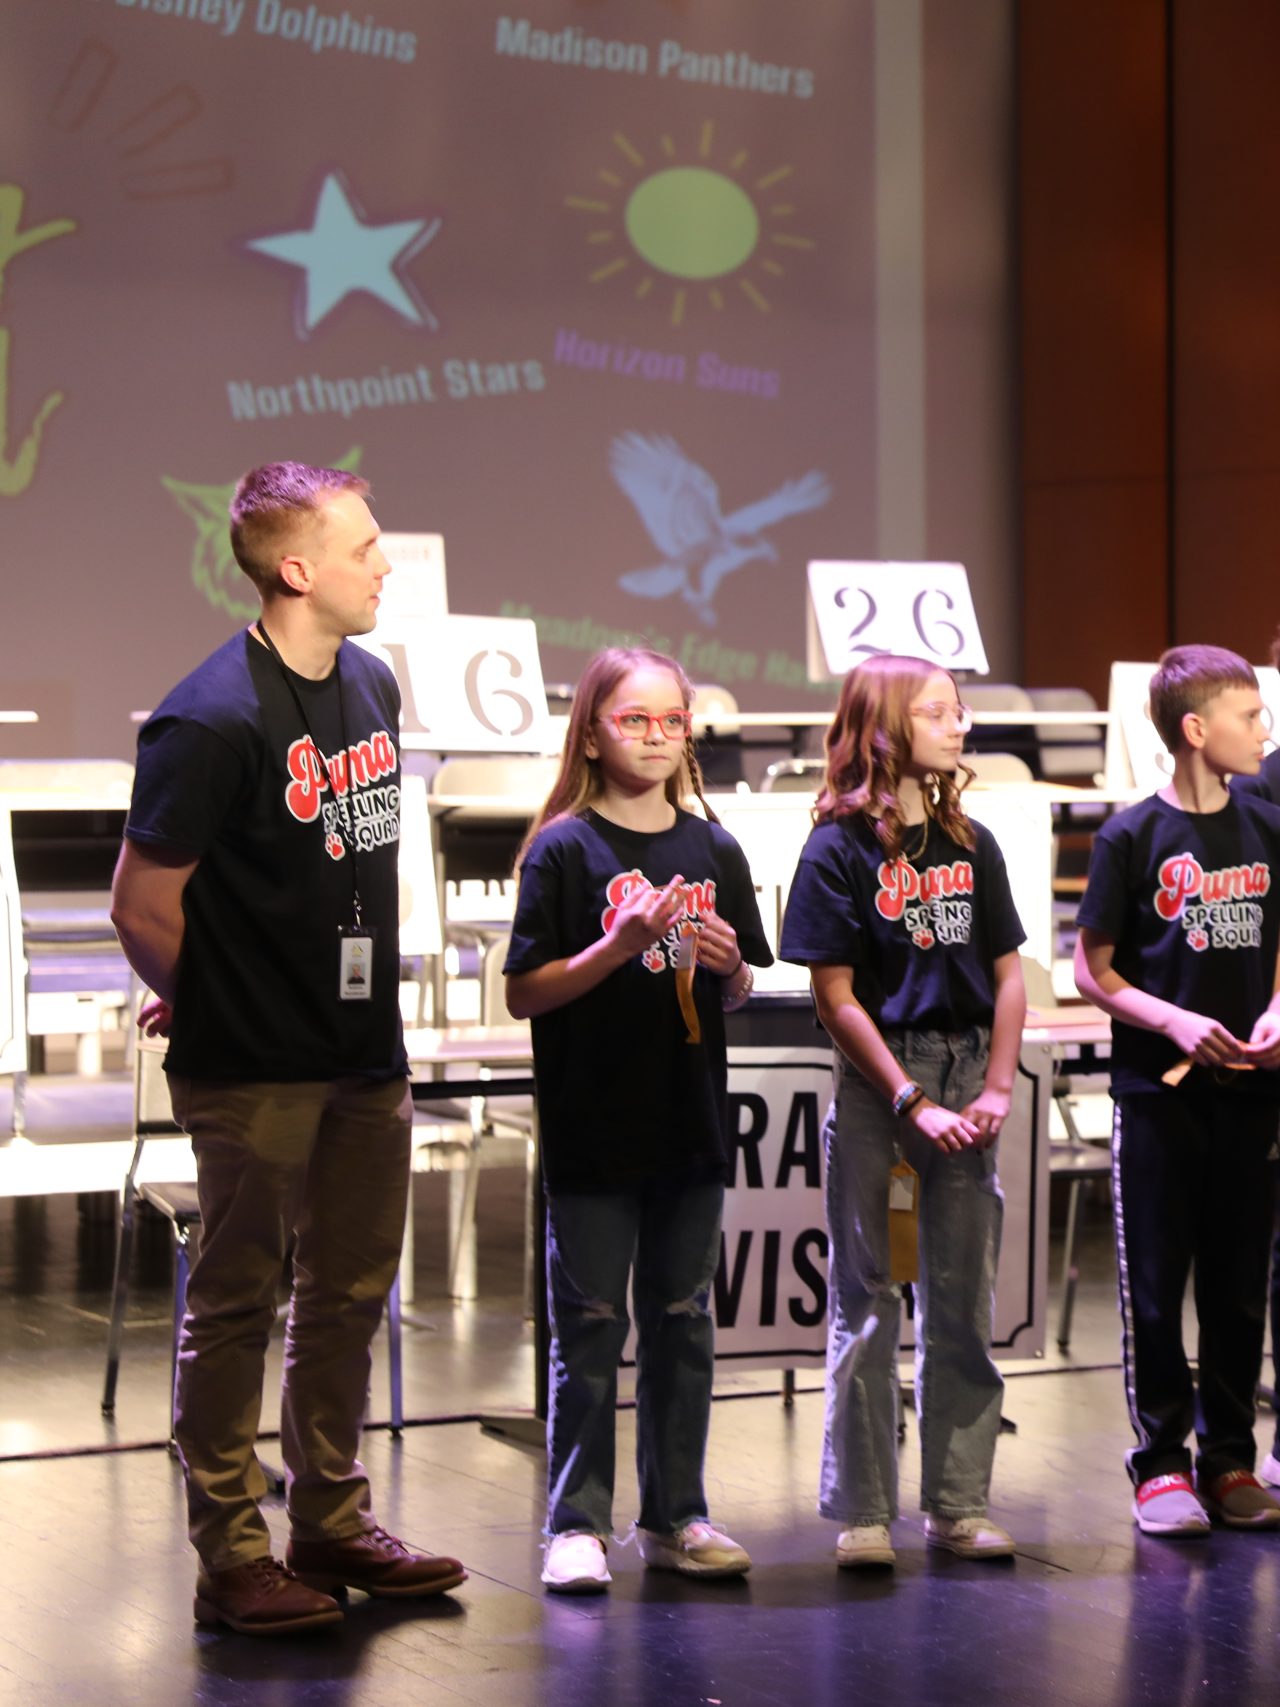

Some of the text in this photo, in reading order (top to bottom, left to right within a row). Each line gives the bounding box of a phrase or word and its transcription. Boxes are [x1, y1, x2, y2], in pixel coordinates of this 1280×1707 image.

[255, 0, 417, 63] Dolphins
[495, 15, 815, 99] Madison Panthers
[227, 358, 546, 421] Northpoint Stars
[552, 327, 781, 399] Horizon Suns
[834, 586, 965, 656] 26
[380, 643, 533, 737] 16
[1154, 851, 1271, 922] Puma
